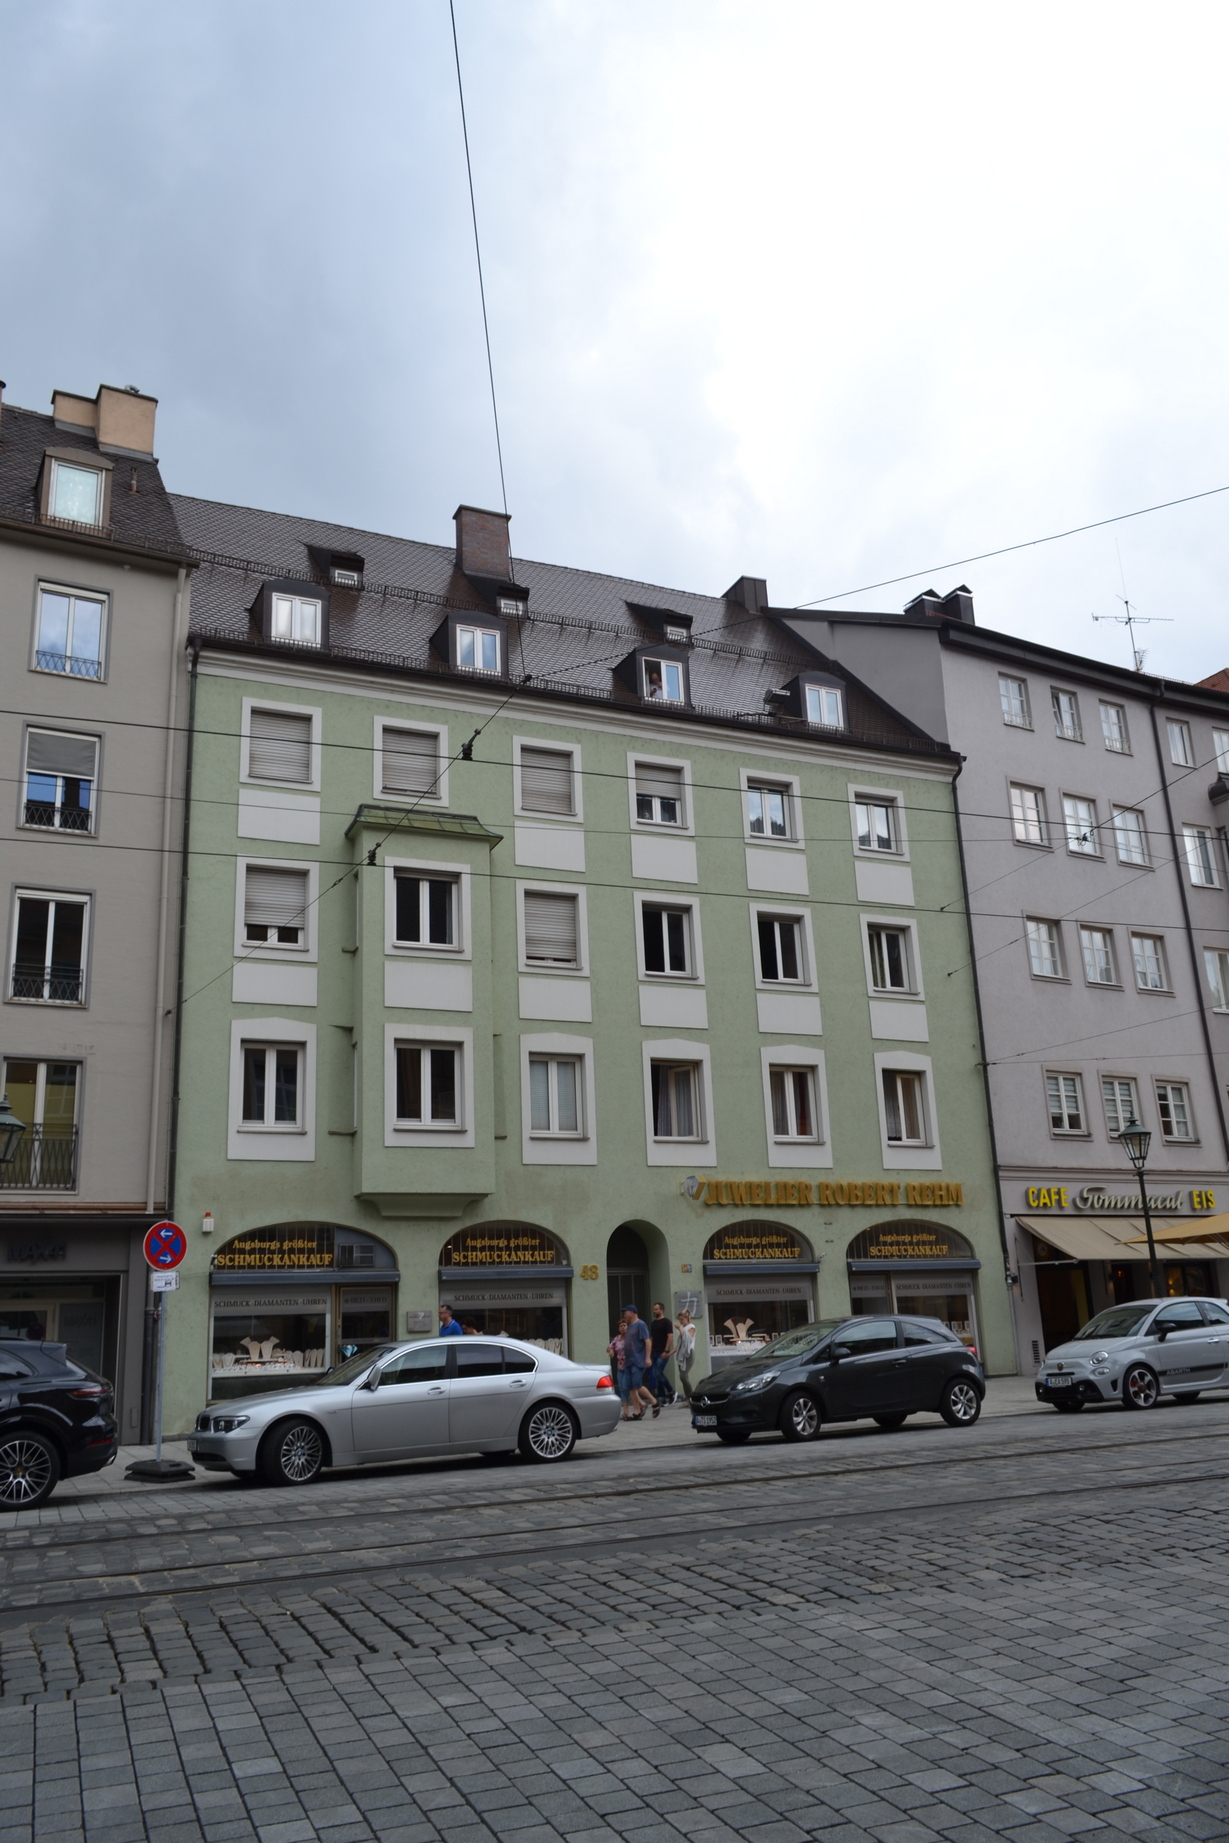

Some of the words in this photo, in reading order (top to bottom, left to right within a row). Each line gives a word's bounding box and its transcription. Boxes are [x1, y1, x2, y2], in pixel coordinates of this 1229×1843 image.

[704, 1180, 814, 1206] JUWELIER
[818, 1182, 901, 1206] ROBERT
[905, 1182, 964, 1206] REHM
[1027, 1186, 1069, 1208] CAFE
[1192, 1190, 1216, 1209] EIS
[465, 1238, 507, 1247] Augsburgs
[509, 1237, 540, 1247] größter
[724, 1236, 760, 1245] Augsburgs
[761, 1235, 788, 1245] größter
[878, 1233, 911, 1243] Augsburgs
[912, 1233, 937, 1242] größter
[232, 1239, 280, 1250] Augsburgs
[282, 1239, 318, 1250] größter
[452, 1251, 555, 1263] SCHMUCKANKAUF
[713, 1247, 800, 1259] SCHMUCKANKAUF
[869, 1245, 948, 1257] SCHMUCKANKAUF
[216, 1253, 333, 1266] SCHMUCKANKAUF
[580, 1264, 599, 1280] 43
[214, 1300, 251, 1308] SCHMUCK
[253, 1299, 299, 1307] DIAMANTEN
[302, 1298, 328, 1306] UHREN
[1166, 1368, 1191, 1376] ABARTH
